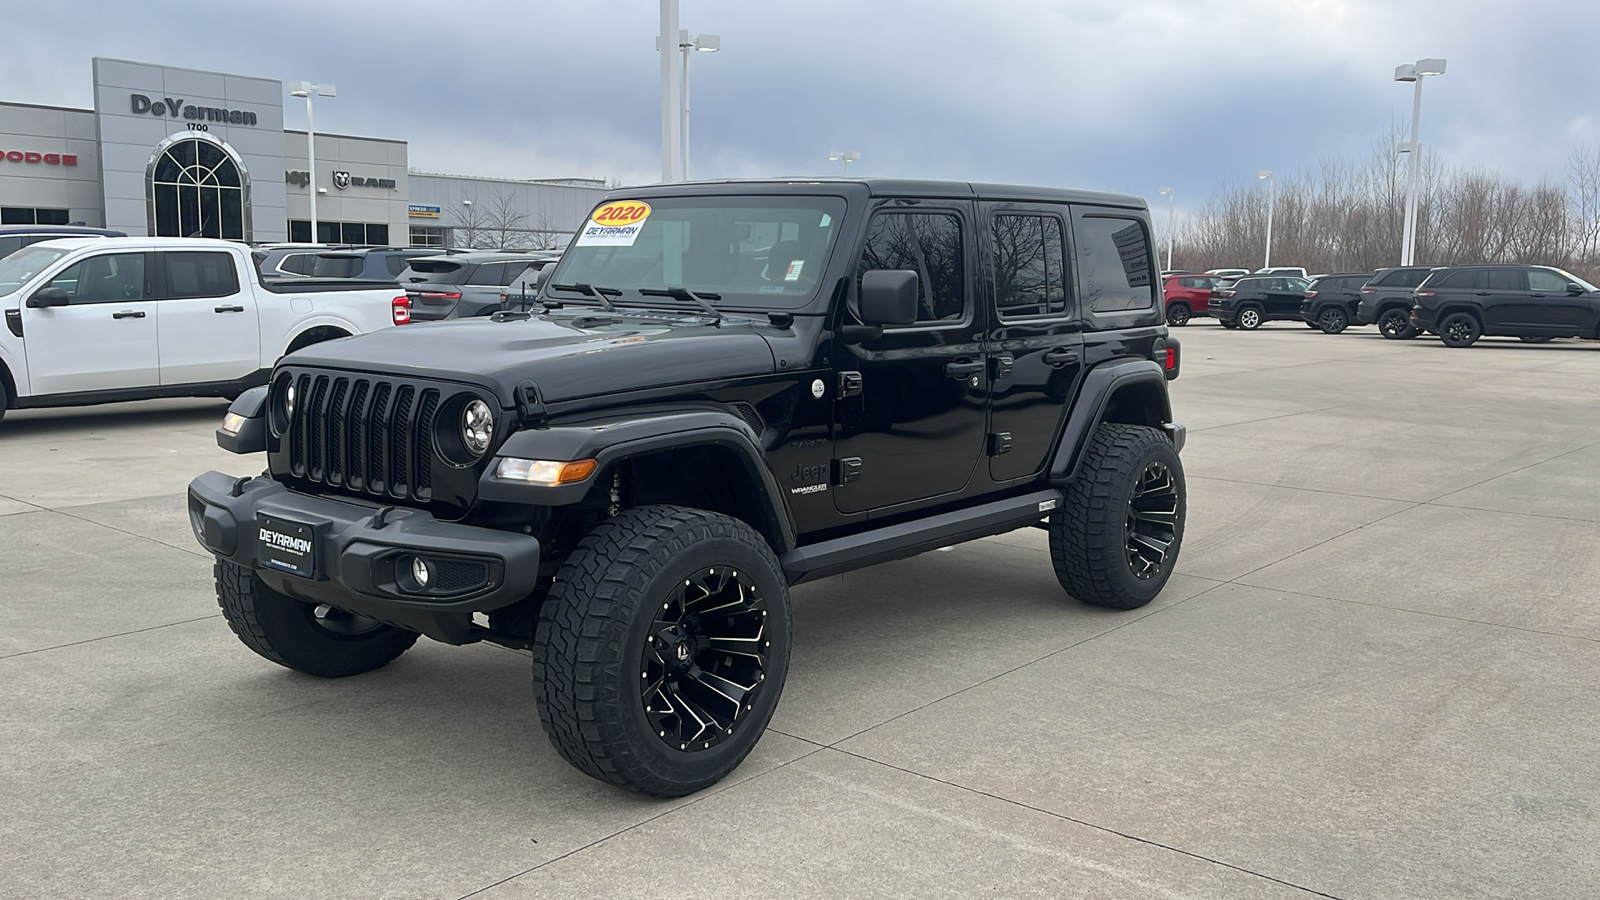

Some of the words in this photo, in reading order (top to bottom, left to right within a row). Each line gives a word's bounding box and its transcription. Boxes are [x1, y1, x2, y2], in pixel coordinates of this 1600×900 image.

[131, 94, 257, 125] DeYarman
[186, 122, 208, 132] 1700
[351, 177, 396, 189] RAM
[596, 206, 647, 221] 2020
[586, 226, 638, 235] DEYARMAN
[791, 463, 827, 481] Jeep
[791, 483, 827, 494] WRANGLER
[259, 528, 311, 552] DEYARMAN
